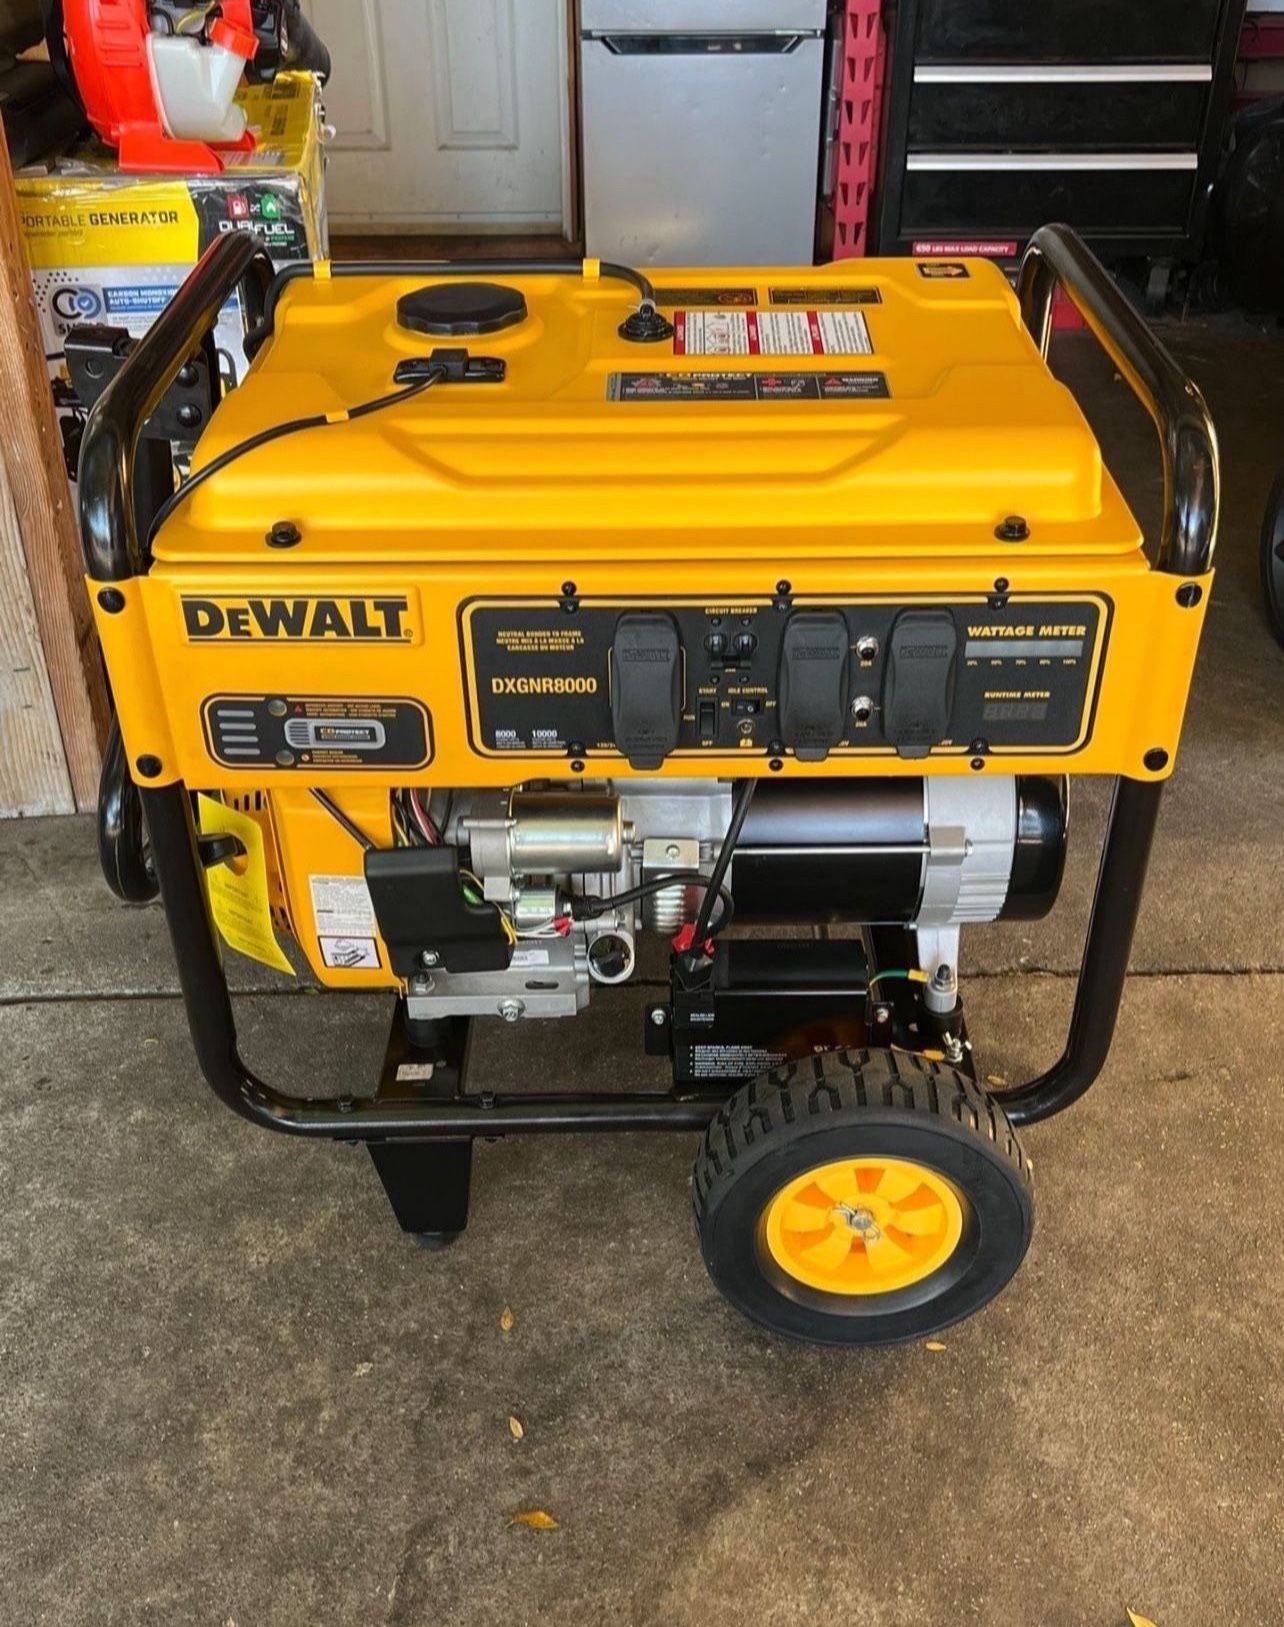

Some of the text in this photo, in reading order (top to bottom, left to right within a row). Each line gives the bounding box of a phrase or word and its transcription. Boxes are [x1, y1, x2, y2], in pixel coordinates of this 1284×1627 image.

[89, 210, 179, 226] GENERATOR
[253, 223, 295, 235] FUEL
[916, 244, 931, 253] 650
[181, 599, 408, 638] DEWALT
[967, 626, 1087, 637] WATTAGE METER
[491, 677, 598, 694] DXGNR8000
[495, 730, 558, 738] 8000 10000
